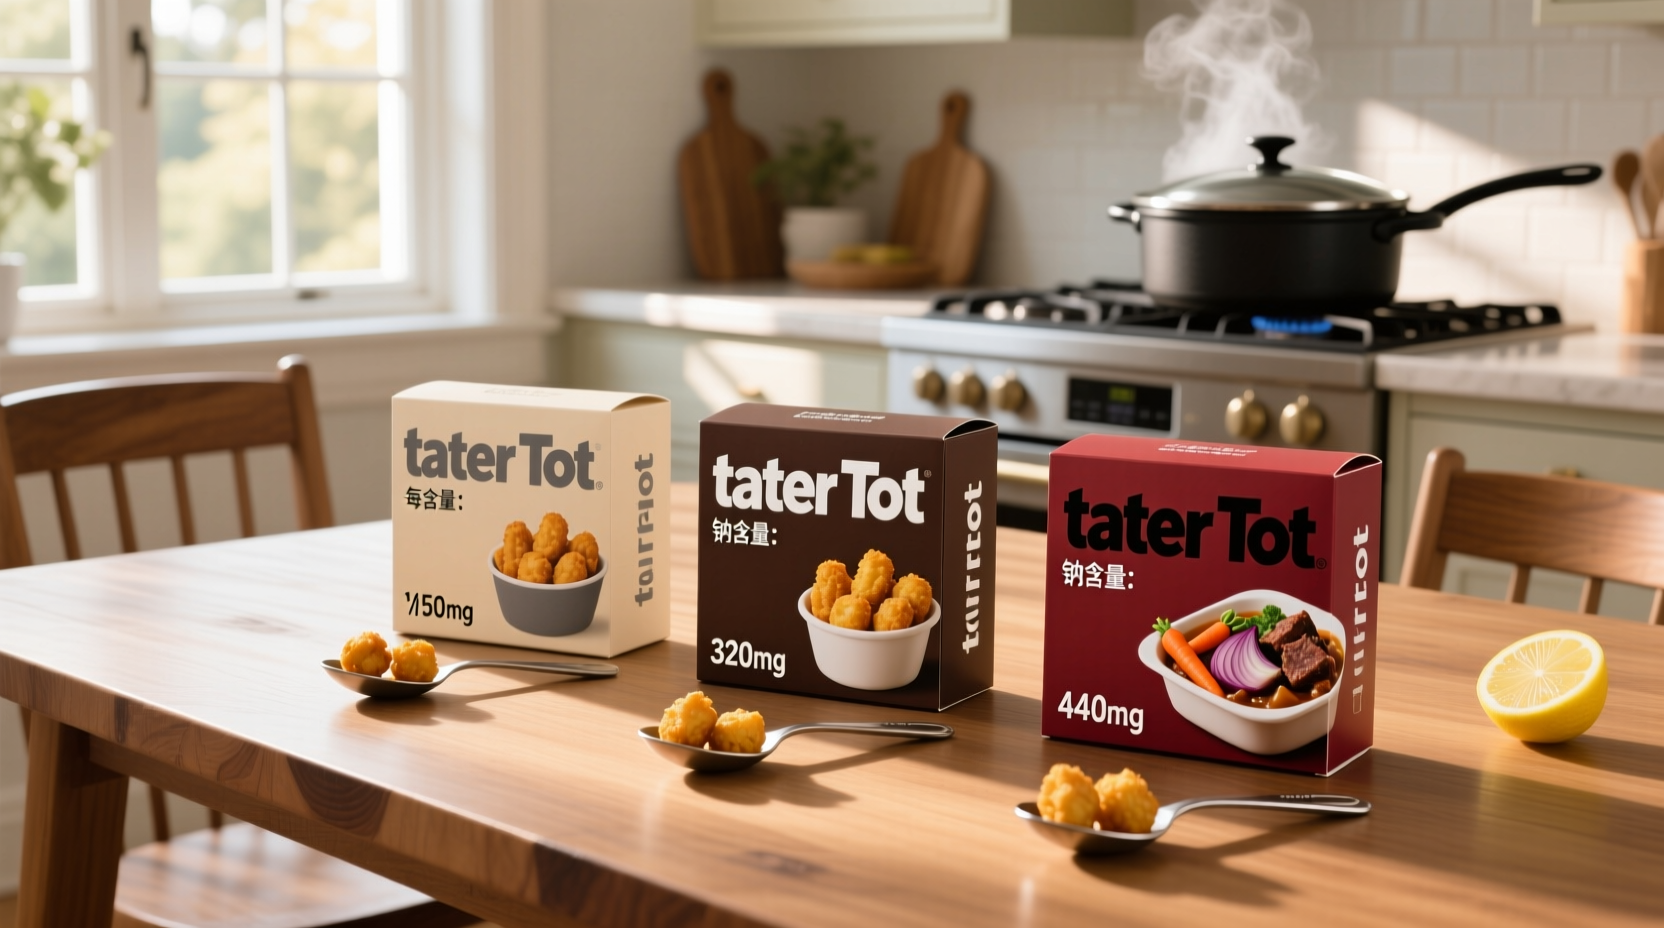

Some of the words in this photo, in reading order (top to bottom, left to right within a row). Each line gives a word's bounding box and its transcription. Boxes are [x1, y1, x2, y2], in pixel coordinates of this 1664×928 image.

[404, 427, 516, 483] tater
[519, 433, 595, 490] Tot
[712, 454, 838, 515] tater
[841, 459, 925, 524] Tot
[1064, 487, 1214, 559] tater
[1217, 495, 1317, 569] Tot
[710, 637, 786, 678] 320mg
[1057, 690, 1144, 735] 440mg
